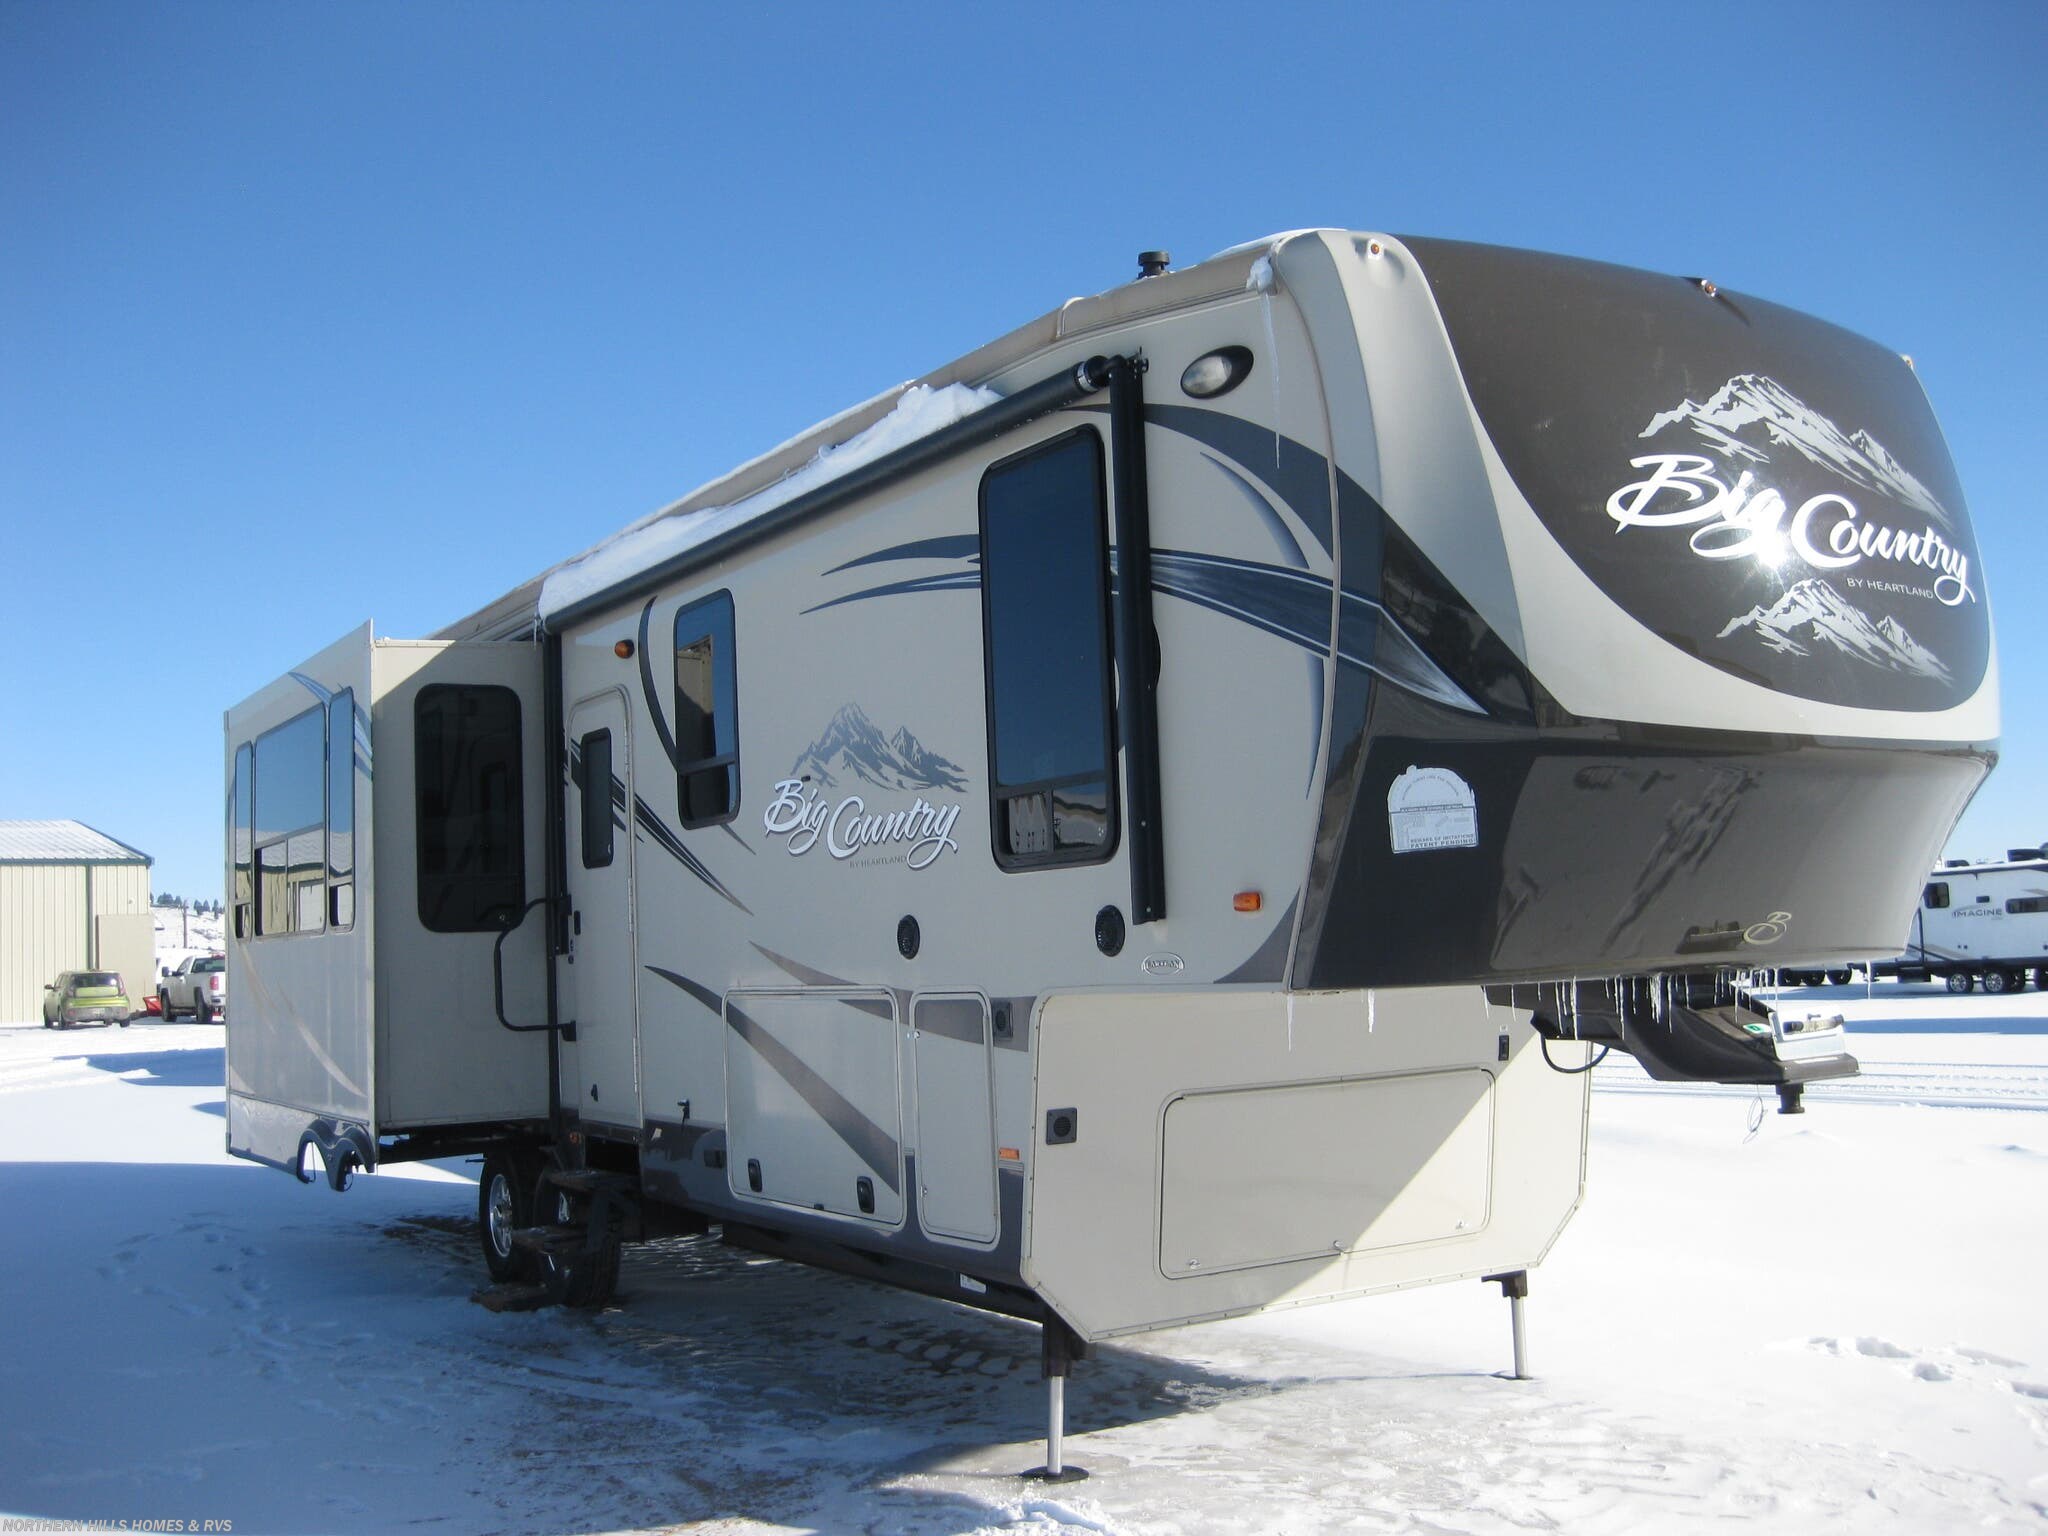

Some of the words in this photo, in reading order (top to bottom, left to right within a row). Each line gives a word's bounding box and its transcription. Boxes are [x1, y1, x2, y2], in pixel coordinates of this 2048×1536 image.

[1606, 453, 1788, 559] Big
[1790, 493, 1976, 607] Country
[1846, 577, 1863, 588] BY
[1867, 580, 1934, 600] HEARTLAND
[763, 779, 829, 855] Big
[827, 795, 961, 870] Country
[1952, 908, 2002, 918] IMAGINE
